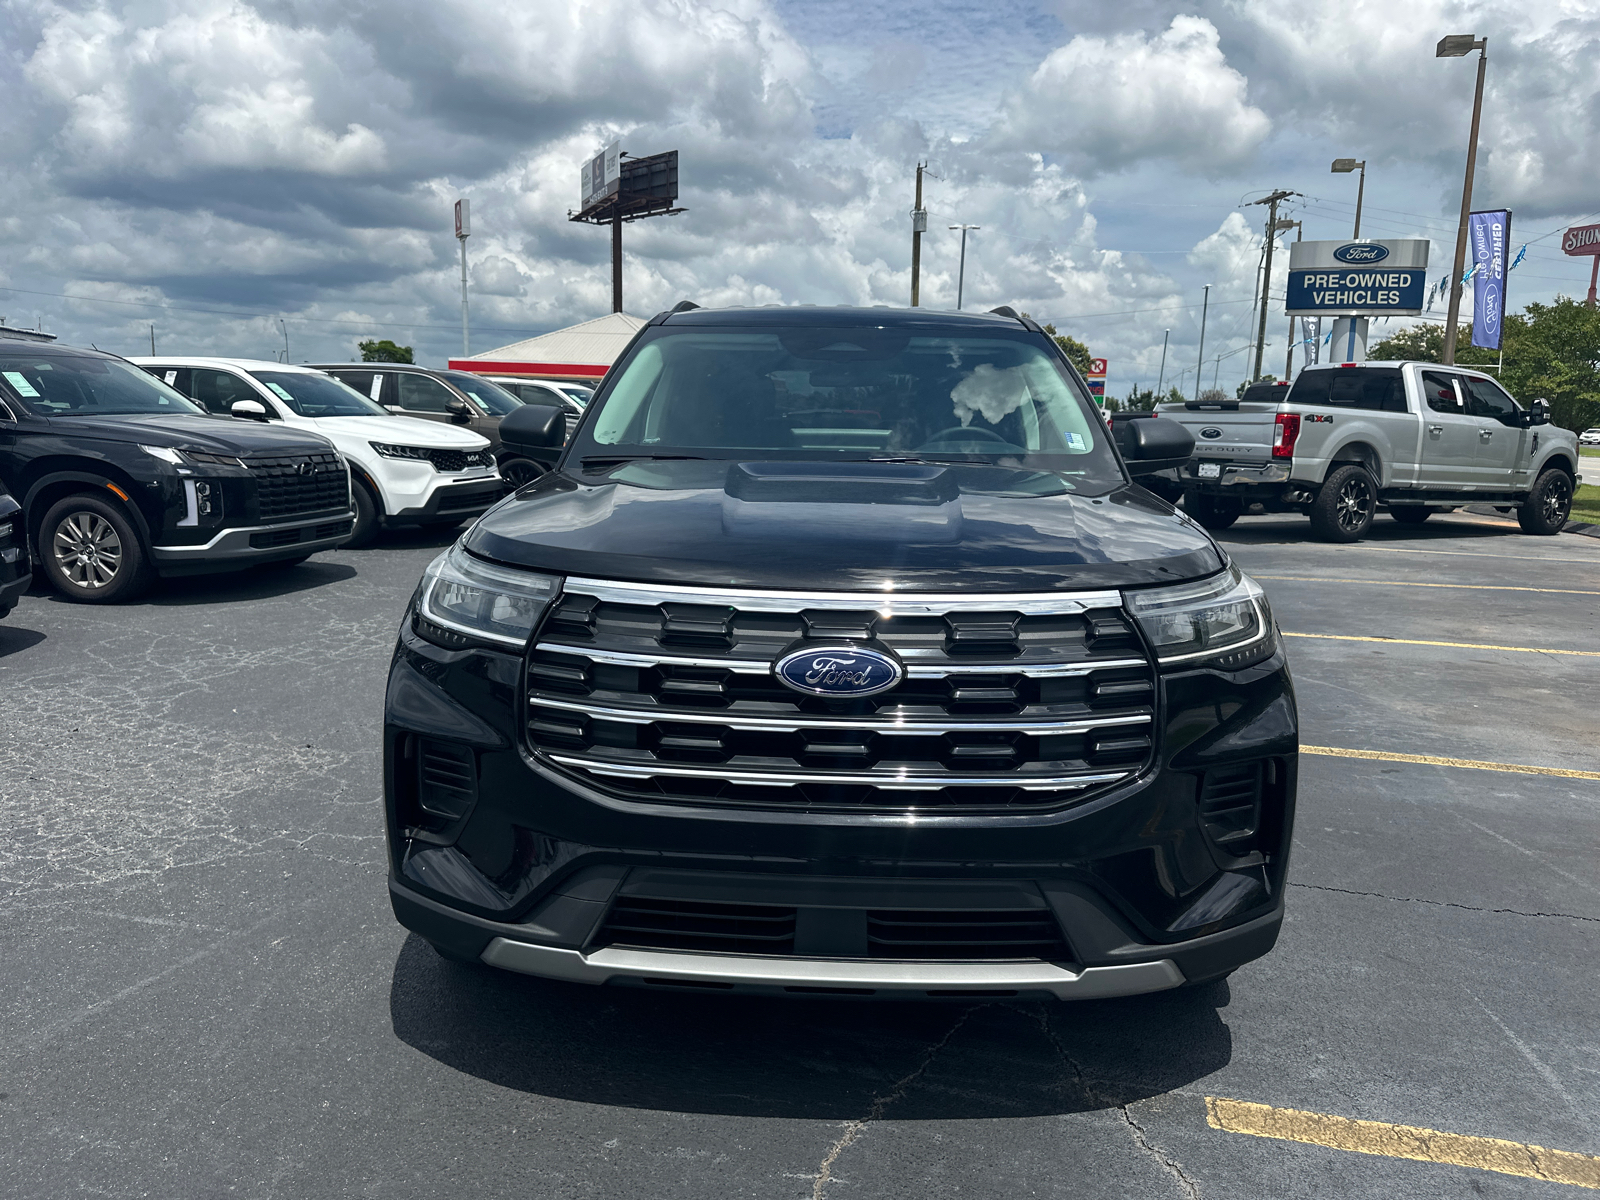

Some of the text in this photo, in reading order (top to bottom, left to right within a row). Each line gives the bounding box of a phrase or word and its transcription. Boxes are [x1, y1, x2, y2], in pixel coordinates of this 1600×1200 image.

[1346, 247, 1378, 259] Ford
[1303, 273, 1412, 288] PRE-OWNED
[1312, 290, 1400, 305] VEHICLES
[805, 657, 872, 686] Ford
